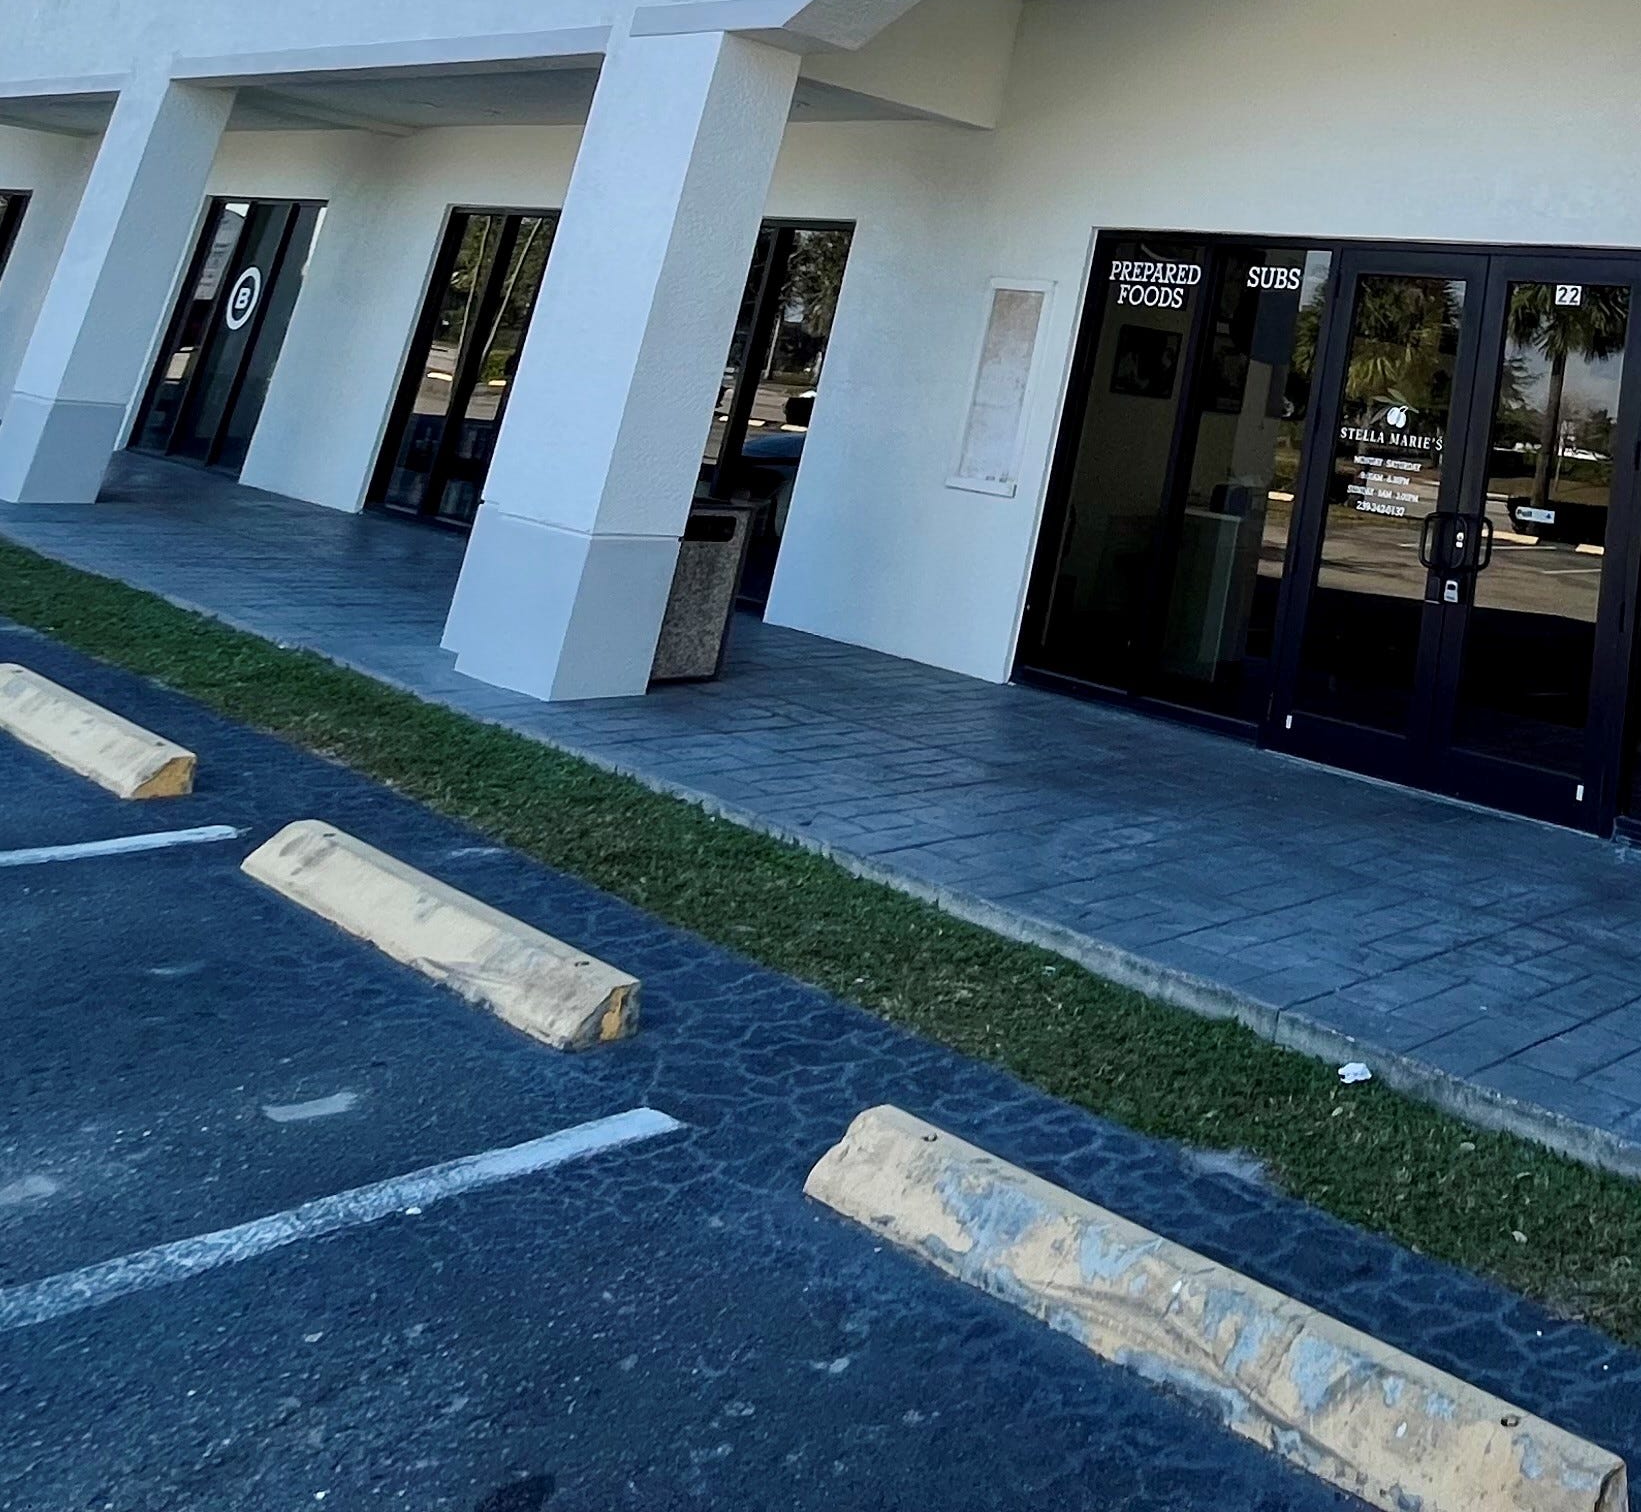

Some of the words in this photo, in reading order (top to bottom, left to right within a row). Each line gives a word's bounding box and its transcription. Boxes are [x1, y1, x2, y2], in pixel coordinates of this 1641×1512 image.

[1108, 260, 1202, 285] PREPARED
[1246, 265, 1302, 290] SUBS
[234, 287, 251, 309] B
[1116, 283, 1184, 309] FOODS
[1557, 286, 1579, 304] 22
[1339, 426, 1385, 444] STELLA
[1388, 432, 1443, 451] MARIE'S
